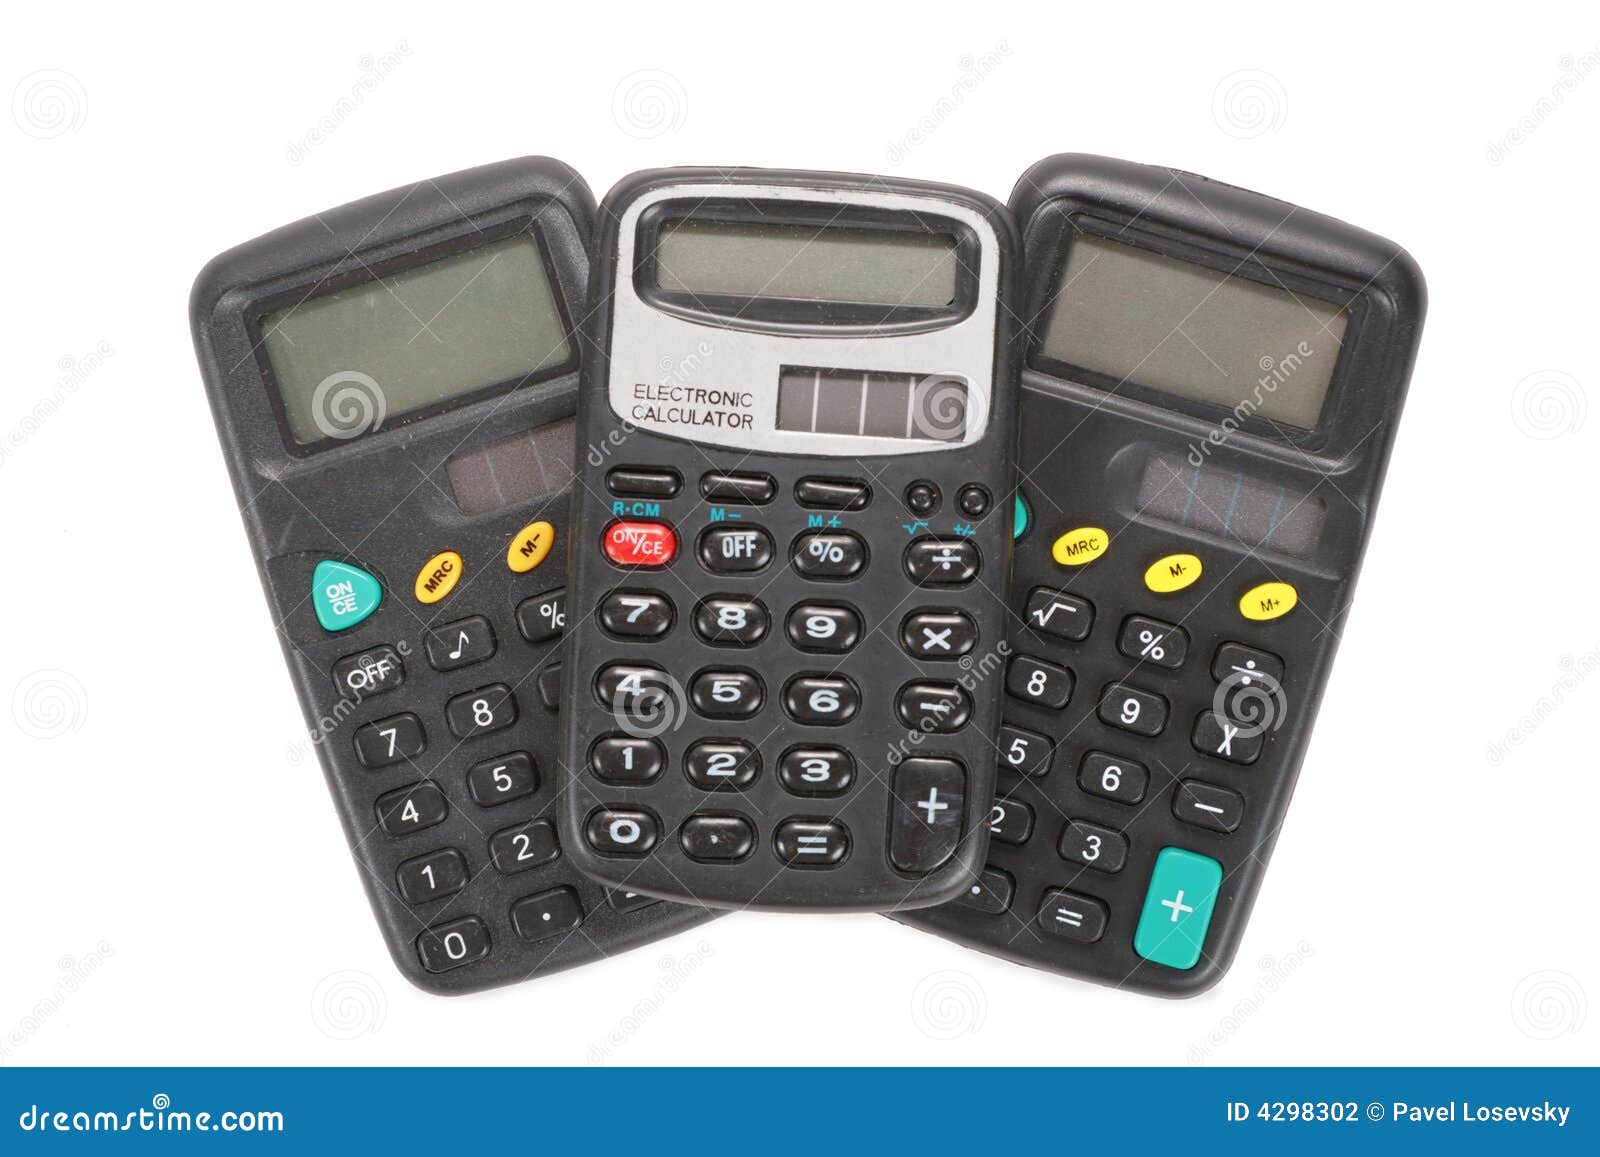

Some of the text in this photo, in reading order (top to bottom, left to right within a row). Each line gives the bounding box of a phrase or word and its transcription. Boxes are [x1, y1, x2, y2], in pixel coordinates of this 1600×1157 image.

[633, 383, 753, 408] ELECTRONIC
[631, 405, 753, 430] CALCULATOR
[722, 536, 757, 558] OFF
[808, 541, 844, 563] %
[1066, 538, 1101, 557] MRC
[424, 560, 454, 594] MRC
[325, 580, 354, 600] ON
[332, 600, 359, 616] CE
[619, 597, 651, 624] 7
[717, 606, 747, 630] 8
[806, 615, 837, 639] 9
[346, 659, 391, 689] OFF
[615, 674, 646, 697] 4
[1027, 670, 1048, 697] 8
[711, 680, 742, 703] 5
[808, 689, 840, 713] 6
[472, 699, 493, 726] 8
[1120, 698, 1141, 725] 9
[379, 728, 397, 757] 7
[1007, 738, 1029, 765] 5
[622, 746, 633, 770] 1
[706, 752, 737, 777] 2
[800, 758, 831, 782] 3
[492, 766, 513, 792] 5
[1101, 765, 1122, 792] 6
[401, 799, 420, 823] 4
[990, 806, 1006, 833] 2
[609, 819, 641, 844] 0
[512, 834, 534, 861] 2
[1081, 835, 1102, 861] 3
[421, 864, 436, 889] 1
[444, 932, 467, 960] 0
